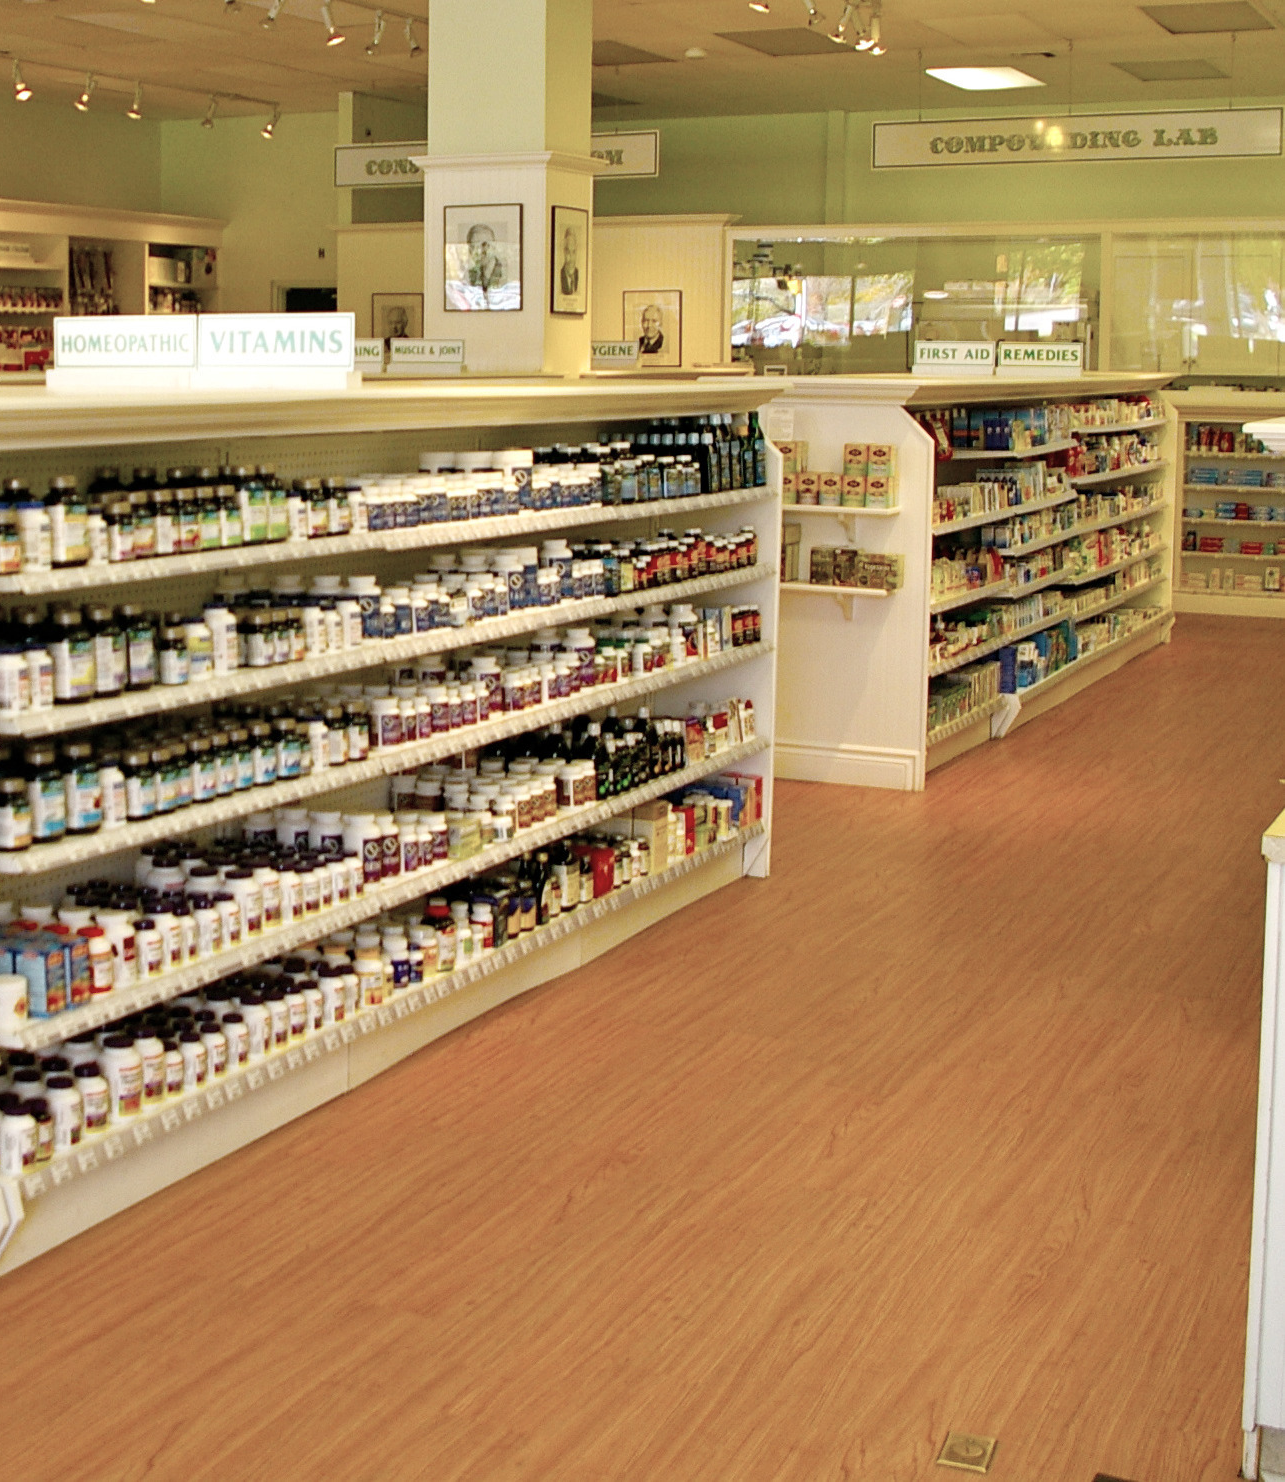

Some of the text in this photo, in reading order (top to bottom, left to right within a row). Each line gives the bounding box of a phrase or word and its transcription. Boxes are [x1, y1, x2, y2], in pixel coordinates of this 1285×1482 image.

[928, 127, 1219, 154] COMPOUDING LAB
[61, 332, 190, 354] HOMEOPATHIC
[210, 329, 344, 354] VITAMINS
[394, 345, 462, 356] MUSCLE & JOINT
[919, 347, 991, 360] FIRST AID
[1003, 348, 1079, 361] REMEDIES
